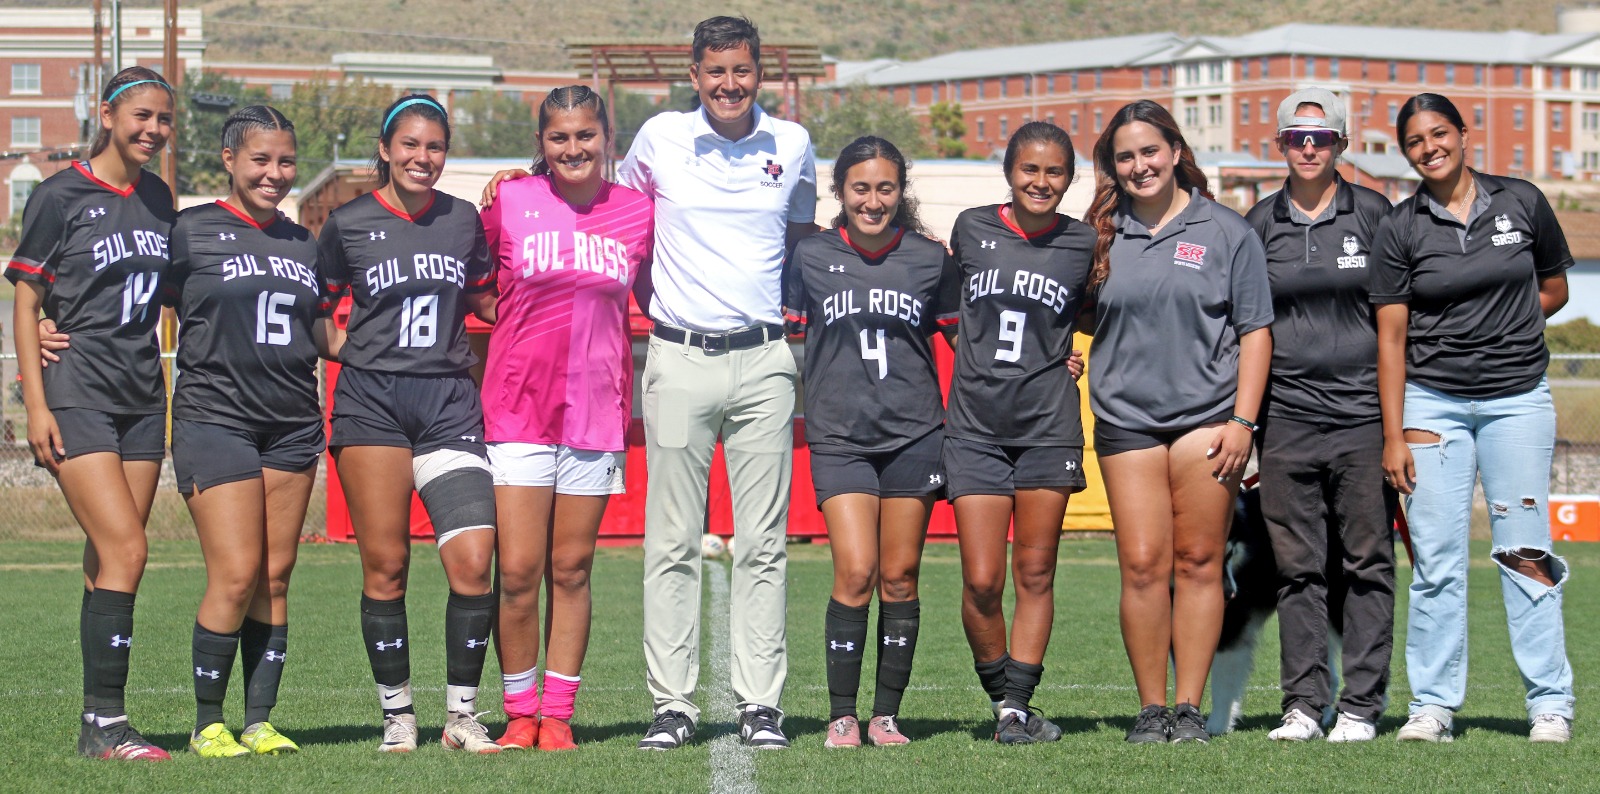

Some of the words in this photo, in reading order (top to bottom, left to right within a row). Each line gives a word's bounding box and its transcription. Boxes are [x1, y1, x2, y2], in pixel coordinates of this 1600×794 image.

[93, 232, 133, 272] SUL
[133, 230, 169, 260] ROS
[522, 230, 564, 279] SUL
[573, 231, 629, 287] ROSS
[1174, 241, 1207, 265] SR
[1491, 231, 1522, 247] SRSU
[223, 254, 266, 282] SUL
[268, 256, 319, 296] ROSS
[366, 257, 408, 297] SUL
[413, 253, 465, 290] ROSS
[1337, 256, 1366, 269] SRSU
[120, 272, 159, 325] 14
[822, 289, 862, 327] SUL
[868, 288, 922, 328] ROSS
[969, 268, 1005, 303] SUL
[1012, 269, 1069, 315] ROSS
[256, 290, 296, 346] 15
[398, 294, 439, 348] 18
[994, 309, 1027, 363] 9
[859, 328, 888, 380] 4
[1557, 504, 1578, 525] G
